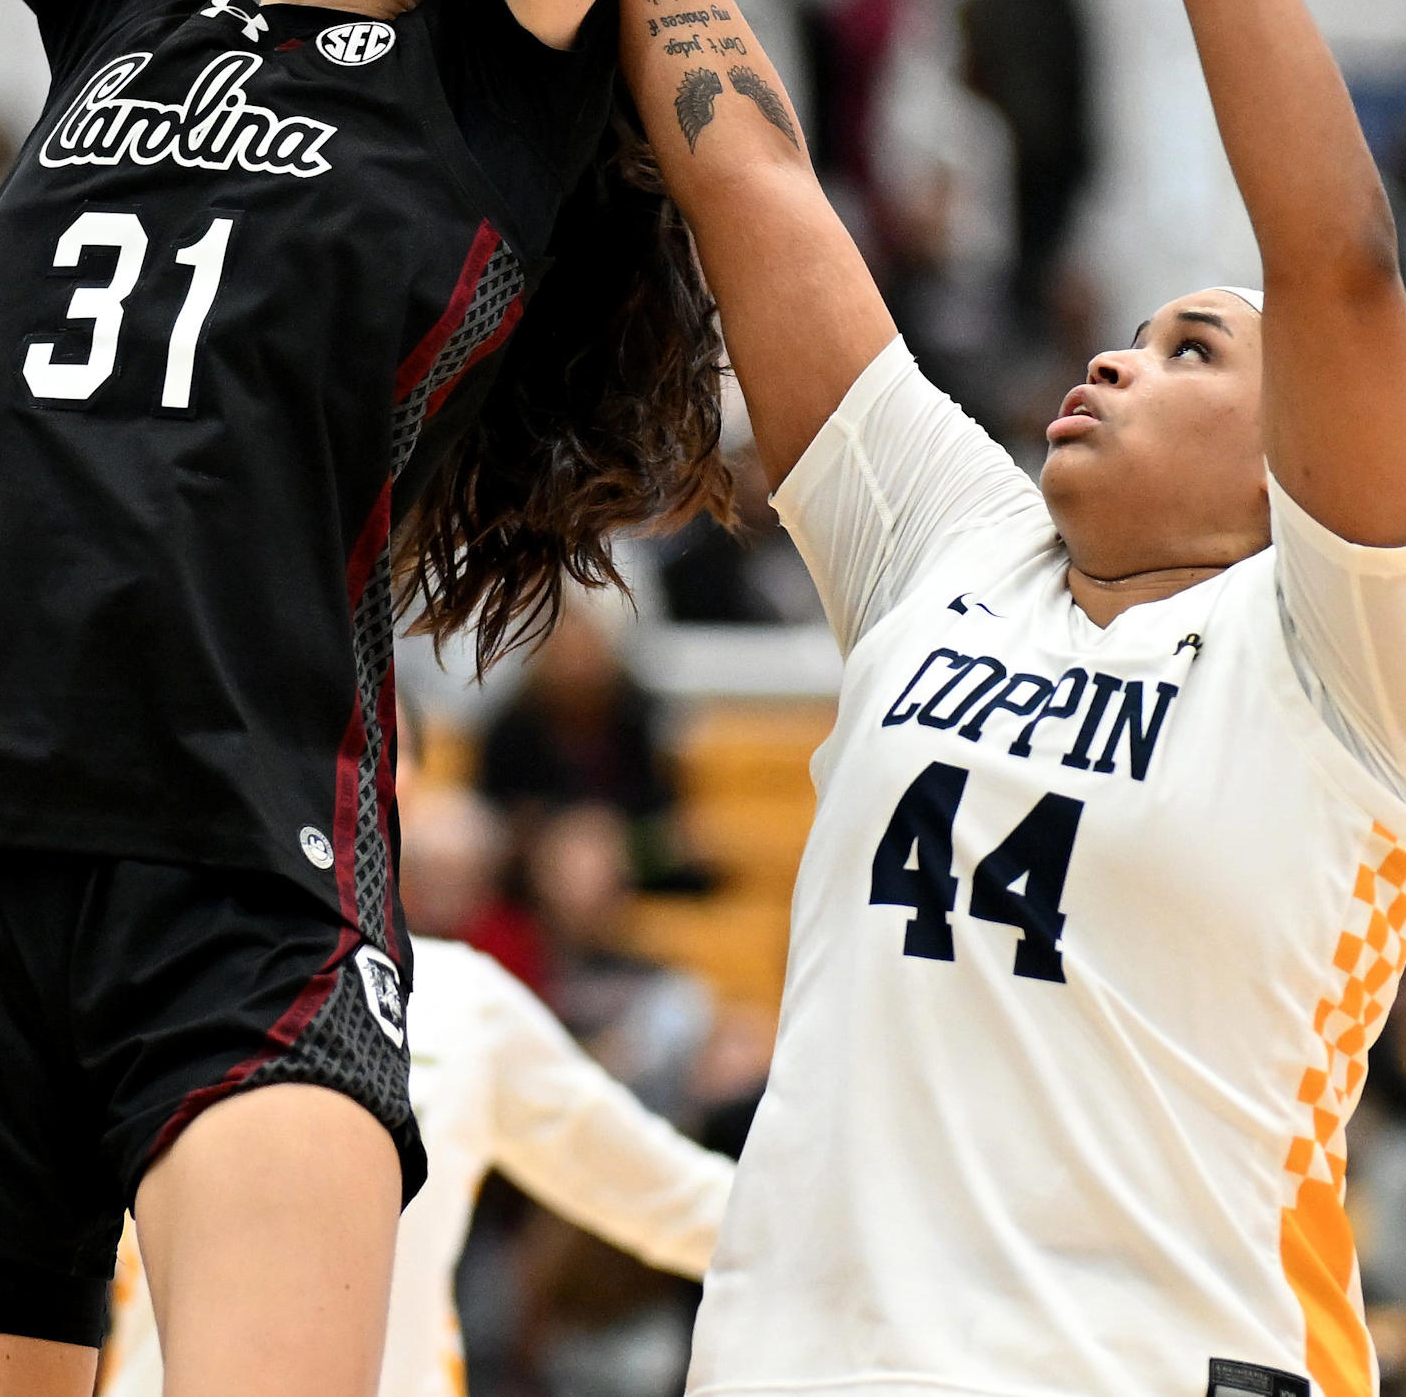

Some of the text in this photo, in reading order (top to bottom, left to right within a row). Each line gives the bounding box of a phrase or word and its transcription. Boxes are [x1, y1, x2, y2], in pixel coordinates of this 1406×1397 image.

[323, 24, 391, 63] SEC
[647, 4, 732, 37] my choices if
[663, 33, 748, 59] Don't judge
[39, 50, 339, 179] Carolina
[22, 211, 235, 410] 31
[881, 647, 1180, 782] COPPIN
[869, 760, 1087, 985] 44
